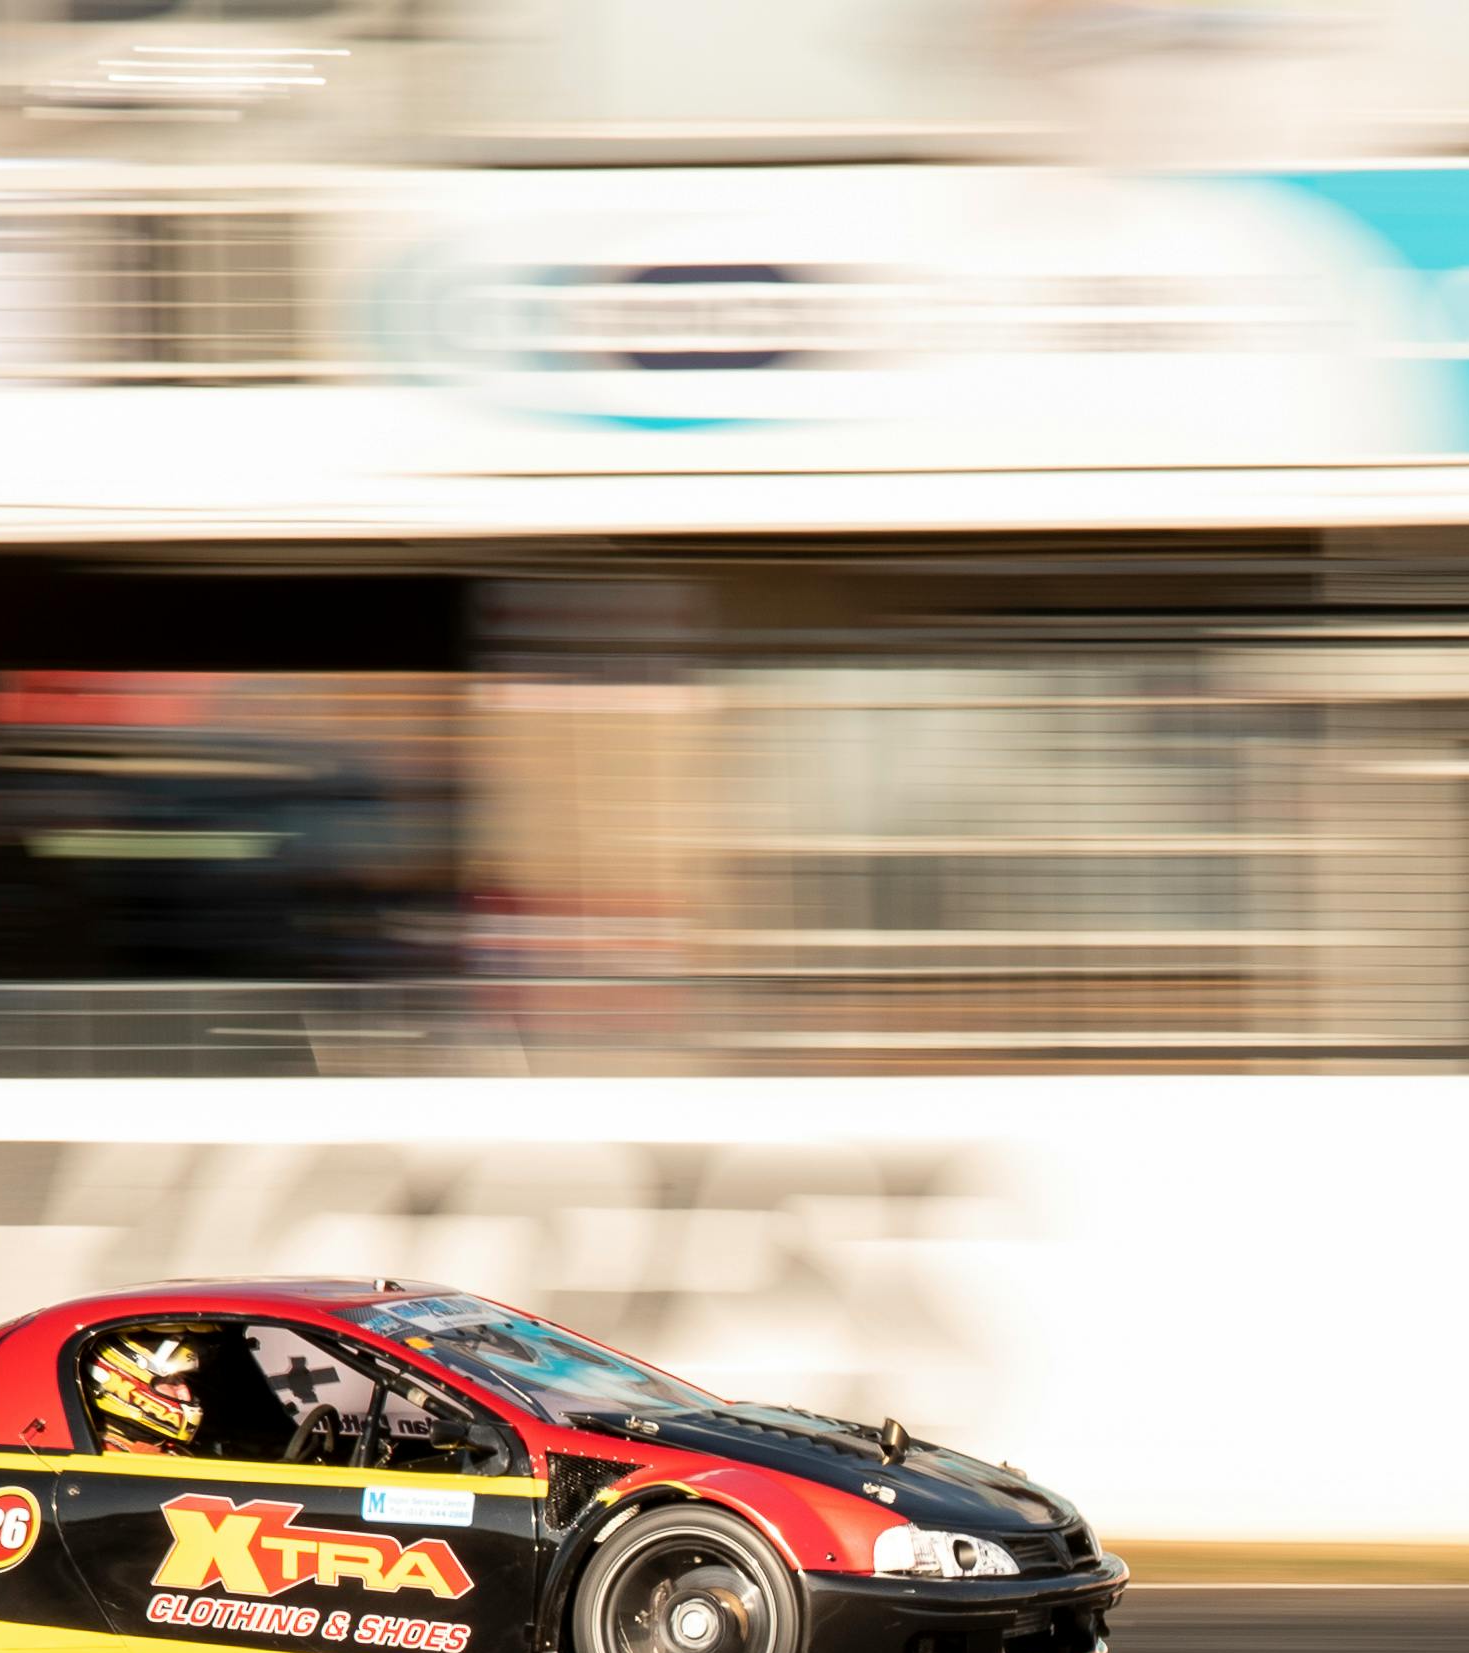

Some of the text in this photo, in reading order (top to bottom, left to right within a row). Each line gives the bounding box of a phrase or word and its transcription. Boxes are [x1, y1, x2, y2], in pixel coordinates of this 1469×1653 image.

[102, 1371, 180, 1428] XTRA
[151, 1493, 474, 1599] XTRA
[146, 1593, 471, 1653] CLOTHING & SHOES
